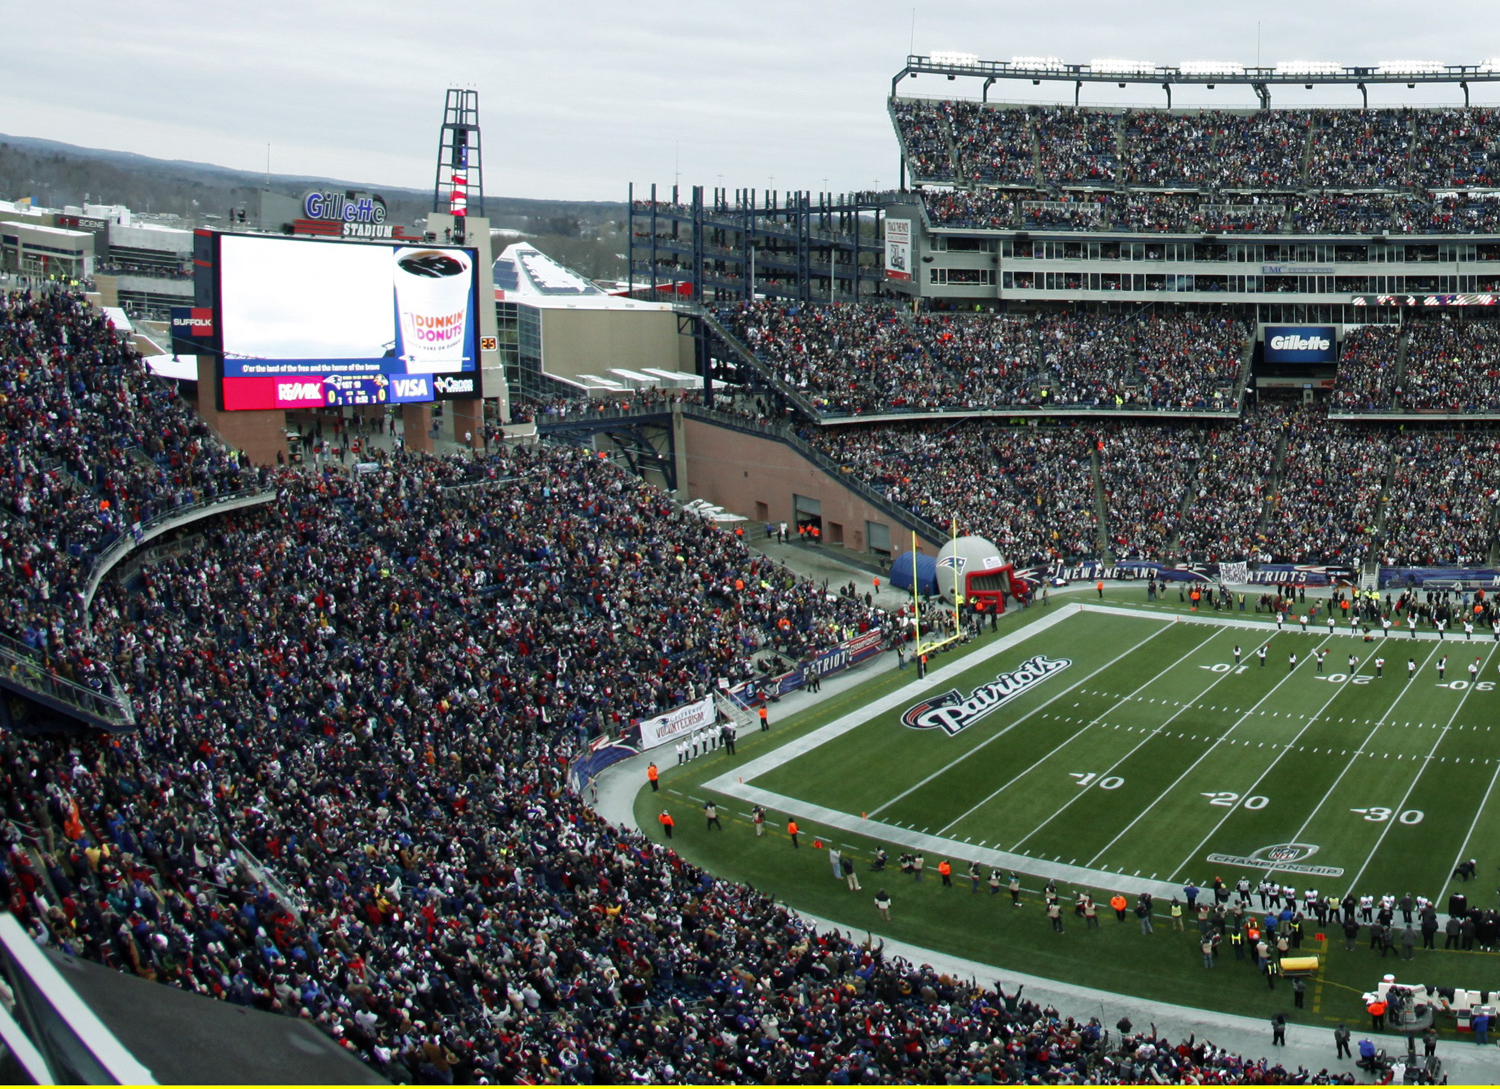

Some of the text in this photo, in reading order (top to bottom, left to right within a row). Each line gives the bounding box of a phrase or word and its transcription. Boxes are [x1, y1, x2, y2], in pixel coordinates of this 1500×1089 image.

[304, 191, 386, 224] Gillette
[79, 219, 105, 229] SCENE
[343, 222, 394, 238] STADIUM
[1262, 265, 1285, 274] EMC
[173, 318, 212, 327] SUFFOLK
[417, 323, 462, 342] DONUTS
[482, 338, 495, 350] 25
[1270, 335, 1330, 351] Gillette
[278, 382, 322, 401] RE/MAX
[378, 388, 386, 402] 0
[391, 378, 428, 397] VISA
[328, 390, 336, 404] 0
[1062, 567, 1093, 580] NEW
[1247, 571, 1308, 583] ATRIOTS
[1327, 673, 1374, 685] 20
[1449, 680, 1497, 691] 30
[914, 655, 1072, 734] Patriots
[655, 711, 705, 739] VOLUNTEERISM
[1076, 772, 1125, 790] 10
[1209, 792, 1270, 810] 20
[1364, 806, 1426, 825] 30
[1274, 852, 1293, 860] NFL
[1213, 855, 1338, 874] CHAMPIONSHIP
